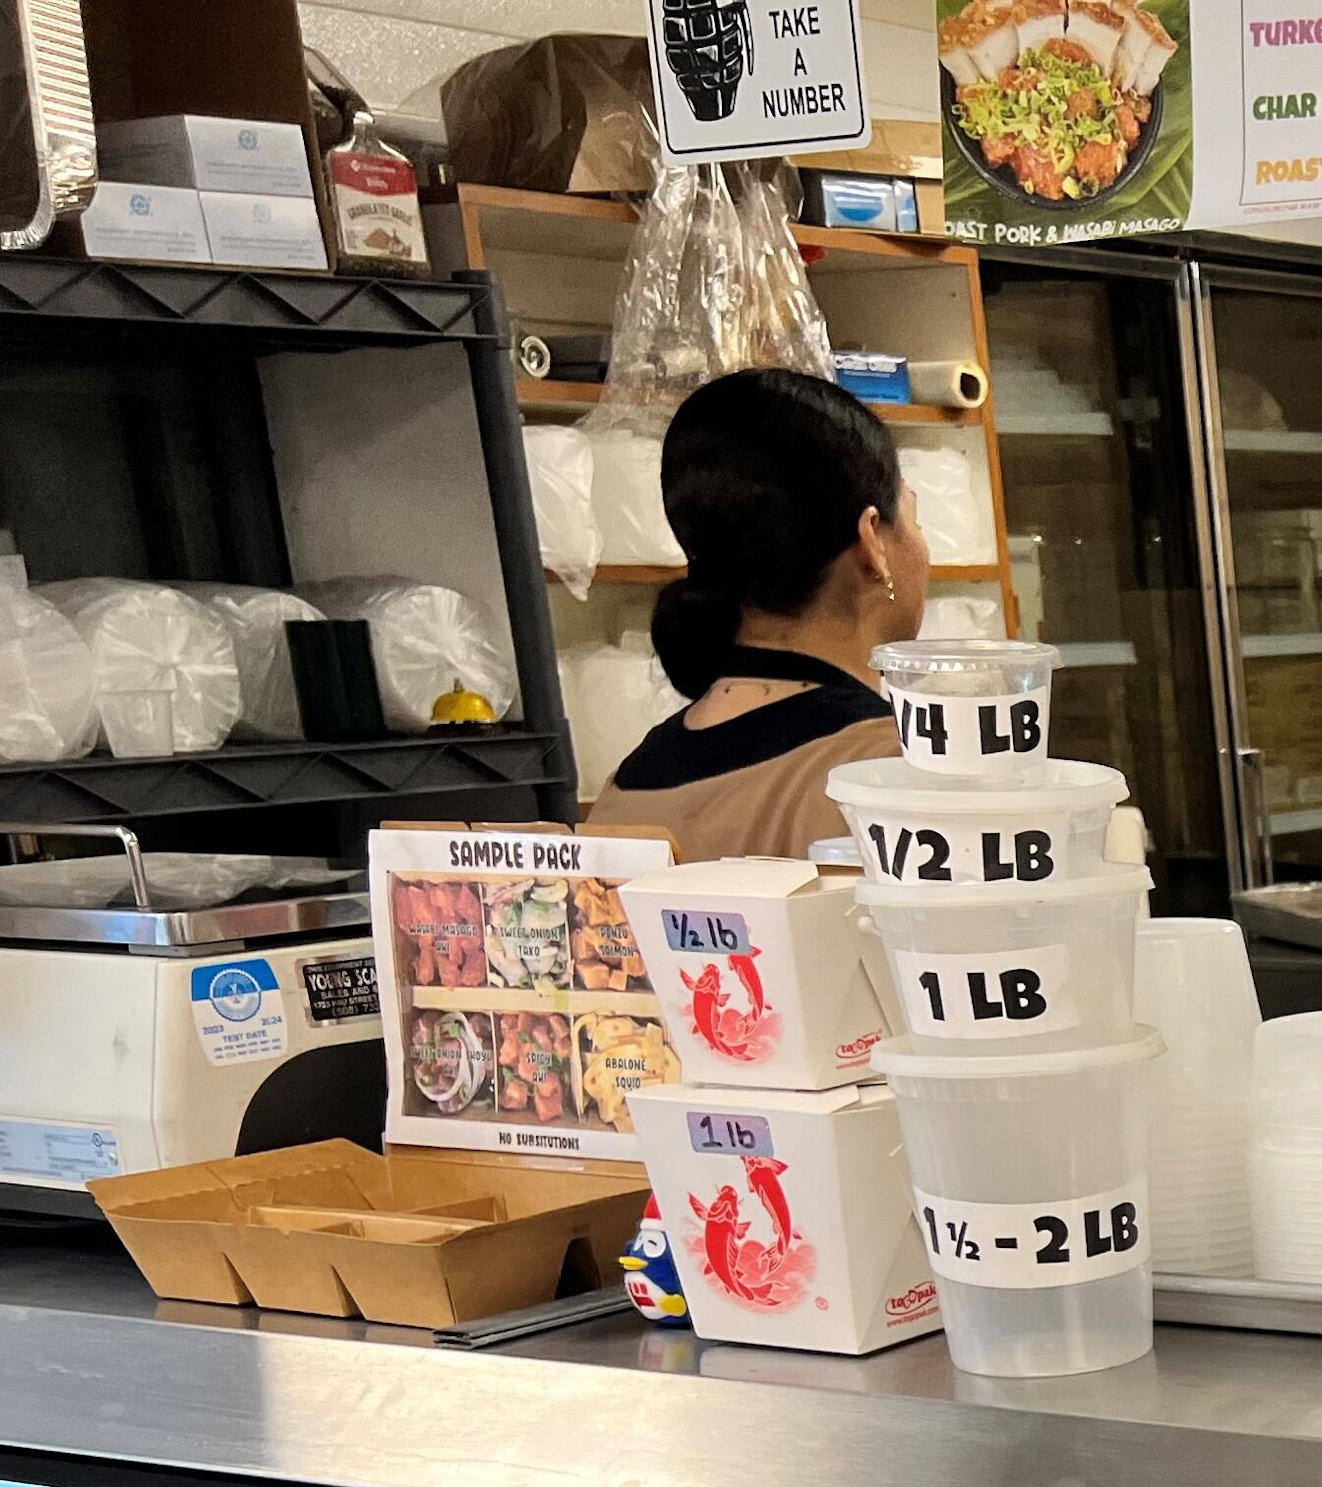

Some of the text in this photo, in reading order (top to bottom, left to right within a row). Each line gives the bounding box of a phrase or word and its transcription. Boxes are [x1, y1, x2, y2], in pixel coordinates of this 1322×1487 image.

[769, 9, 821, 39] TAKE
[794, 50, 808, 76] A
[763, 88, 846, 118] NUMBER
[1253, 92, 1317, 121] CHAR
[944, 221, 987, 240] OAST
[995, 223, 1042, 246] PORK
[1045, 225, 1058, 242] &
[1119, 218, 1181, 235] MASAGO
[978, 700, 1042, 754] LB
[450, 840, 582, 870] SAMPLE PACK
[868, 823, 1055, 883] 1/2 LB
[309, 967, 378, 993] YOUNG SCA
[918, 968, 1047, 1021] 1 LB
[604, 1056, 647, 1072] ABALONE
[615, 1075, 642, 1090] SQUID
[498, 1132, 513, 1146] NO
[699, 1116, 757, 1151] 1 lb
[1034, 1215, 1071, 1264] 2
[1083, 1201, 1140, 1256] LB
